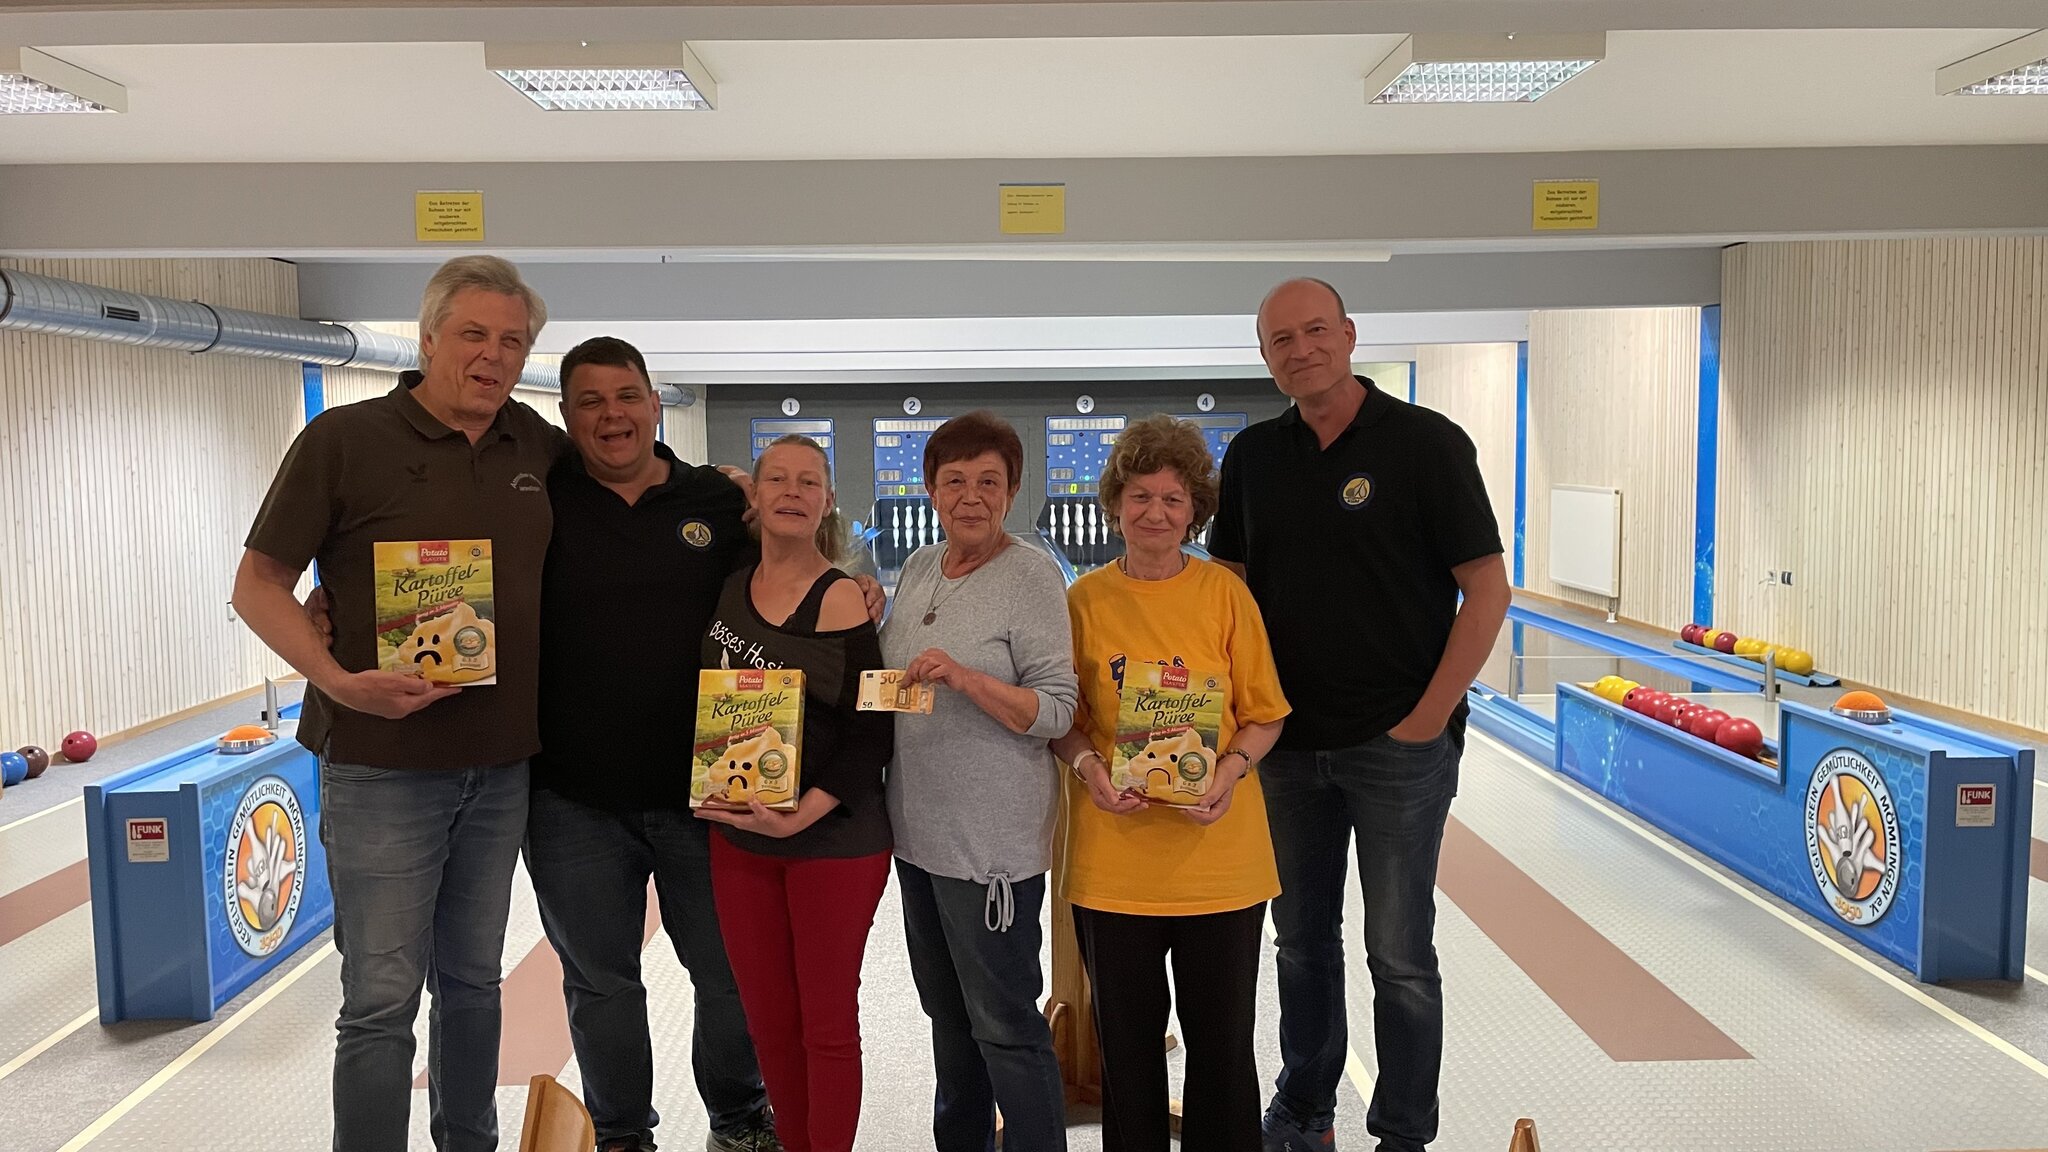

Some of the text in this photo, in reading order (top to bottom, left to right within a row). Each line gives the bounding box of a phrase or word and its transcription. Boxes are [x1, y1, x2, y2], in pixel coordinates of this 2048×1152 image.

[788, 402, 794, 412] 1
[908, 401, 916, 411] 2
[1082, 399, 1089, 410] 3
[1201, 397, 1210, 408] 4
[421, 548, 448, 557] Potato
[394, 564, 480, 596] Kartoffel-
[418, 586, 464, 608] Püree
[708, 620, 746, 654] Böses
[739, 675, 762, 684] Potato
[880, 672, 896, 685] 50
[1163, 672, 1187, 682] Potato
[712, 691, 789, 719] Kartoffel-
[1134, 693, 1212, 712] Kartoffel-
[730, 712, 772, 731] Püree
[1152, 711, 1195, 727] Püree
[1816, 755, 1882, 790] GEMÜTLICHKEIT
[1967, 790, 1991, 800] FUNK
[232, 783, 286, 840] GEMÜTLICHKEIT
[136, 824, 163, 834] FUNK
[1808, 786, 1828, 888] KEGELVEREIN
[286, 796, 305, 892] MÖMLINGEN
[1879, 794, 1898, 901] MÖMLINGEN
[226, 848, 252, 946] KEGELVEREIN
